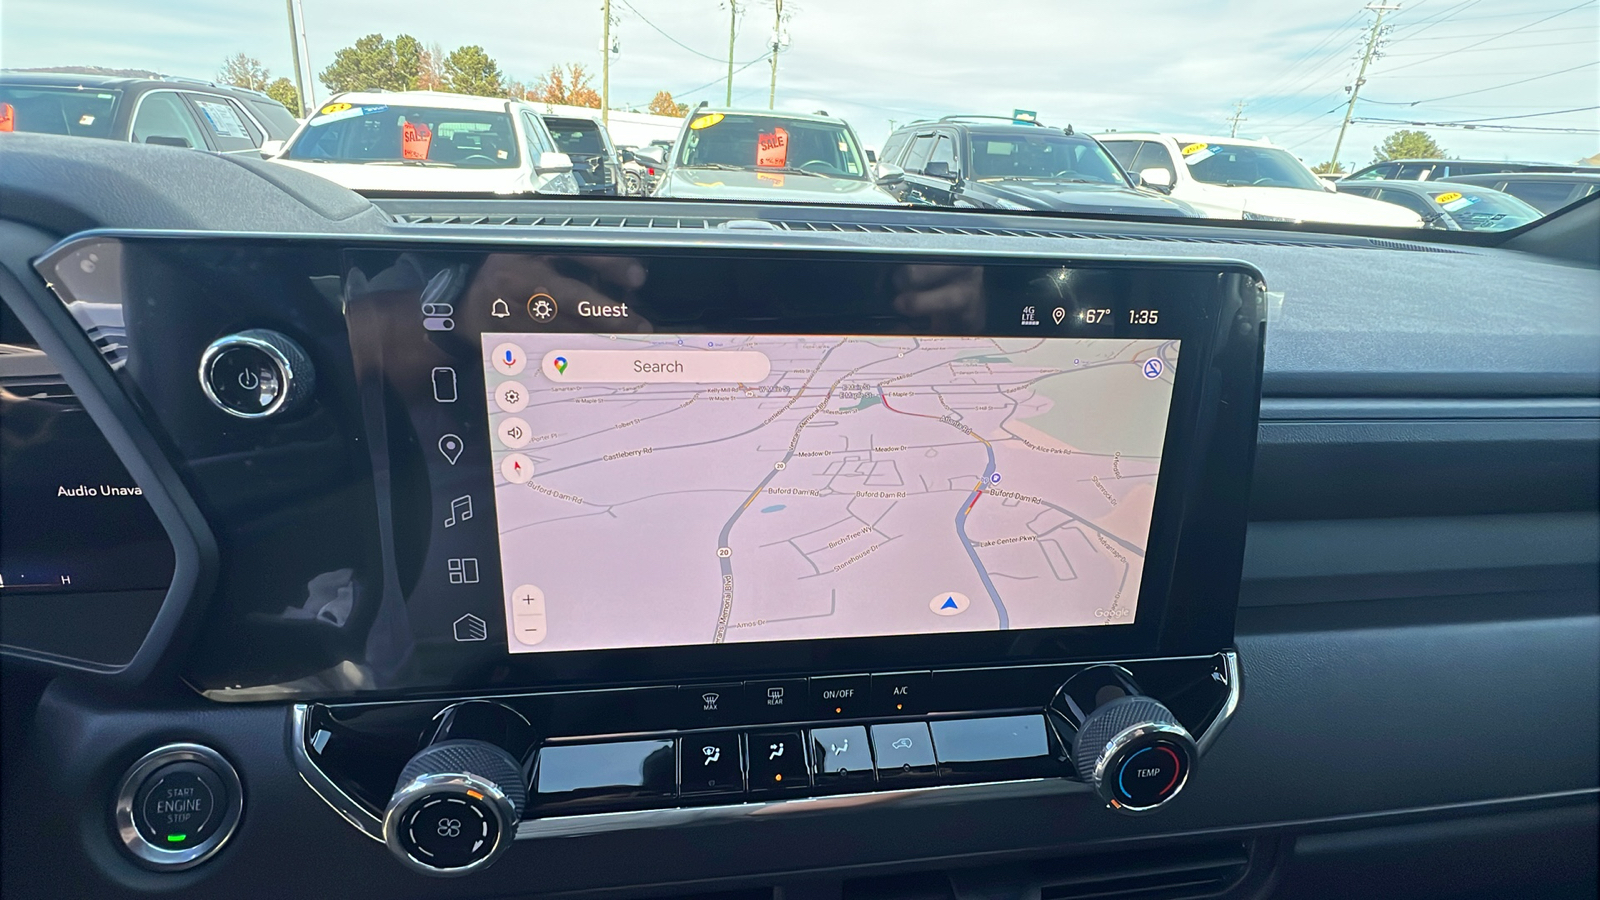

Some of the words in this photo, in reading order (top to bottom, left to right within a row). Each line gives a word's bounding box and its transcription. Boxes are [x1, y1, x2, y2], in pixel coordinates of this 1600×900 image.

[404, 130, 428, 143] SALE
[760, 136, 785, 151] SALE
[577, 301, 629, 317] Guest
[1022, 306, 1036, 314] 4G
[1128, 310, 1159, 324] 1:35
[633, 360, 684, 373] Search
[763, 405, 790, 425] Castleberry
[615, 421, 634, 429] Tolbert
[1023, 440, 1036, 450] Mary
[1036, 445, 1050, 453] Alice
[603, 449, 642, 461] Castleberry
[57, 485, 98, 497] Audio
[100, 484, 143, 496] Unava
[527, 480, 553, 496] Buford
[553, 491, 571, 500] Dam
[572, 495, 583, 504] Rd
[792, 488, 808, 496] Dam
[809, 489, 819, 497] Rd
[856, 490, 879, 498] Buford
[1092, 475, 1112, 500] Shamrock
[989, 488, 1014, 500] Buford
[1014, 492, 1030, 503] Dam
[1030, 496, 1042, 505] Rd
[828, 538, 845, 549] Birch
[845, 532, 861, 542] Tree
[861, 526, 873, 535] Wy
[980, 540, 996, 548] Lake
[996, 536, 1019, 545] Center
[1019, 535, 1037, 543] Pkwy
[1099, 536, 1122, 559] Advantage
[834, 550, 870, 573] Stonehouse
[870, 544, 879, 553] Dr
[61, 575, 71, 585] H
[724, 575, 732, 591] Blvd
[719, 592, 731, 625] Memorial
[1094, 606, 1130, 618] Google
[736, 620, 756, 629] Amos
[757, 619, 766, 627] Dr
[823, 688, 855, 699] ON/OFF
[893, 686, 909, 696] A/C
[1137, 767, 1160, 778] TEMP
[167, 787, 194, 798] START
[157, 799, 201, 814] ENGINE
[167, 812, 191, 824] STOP
